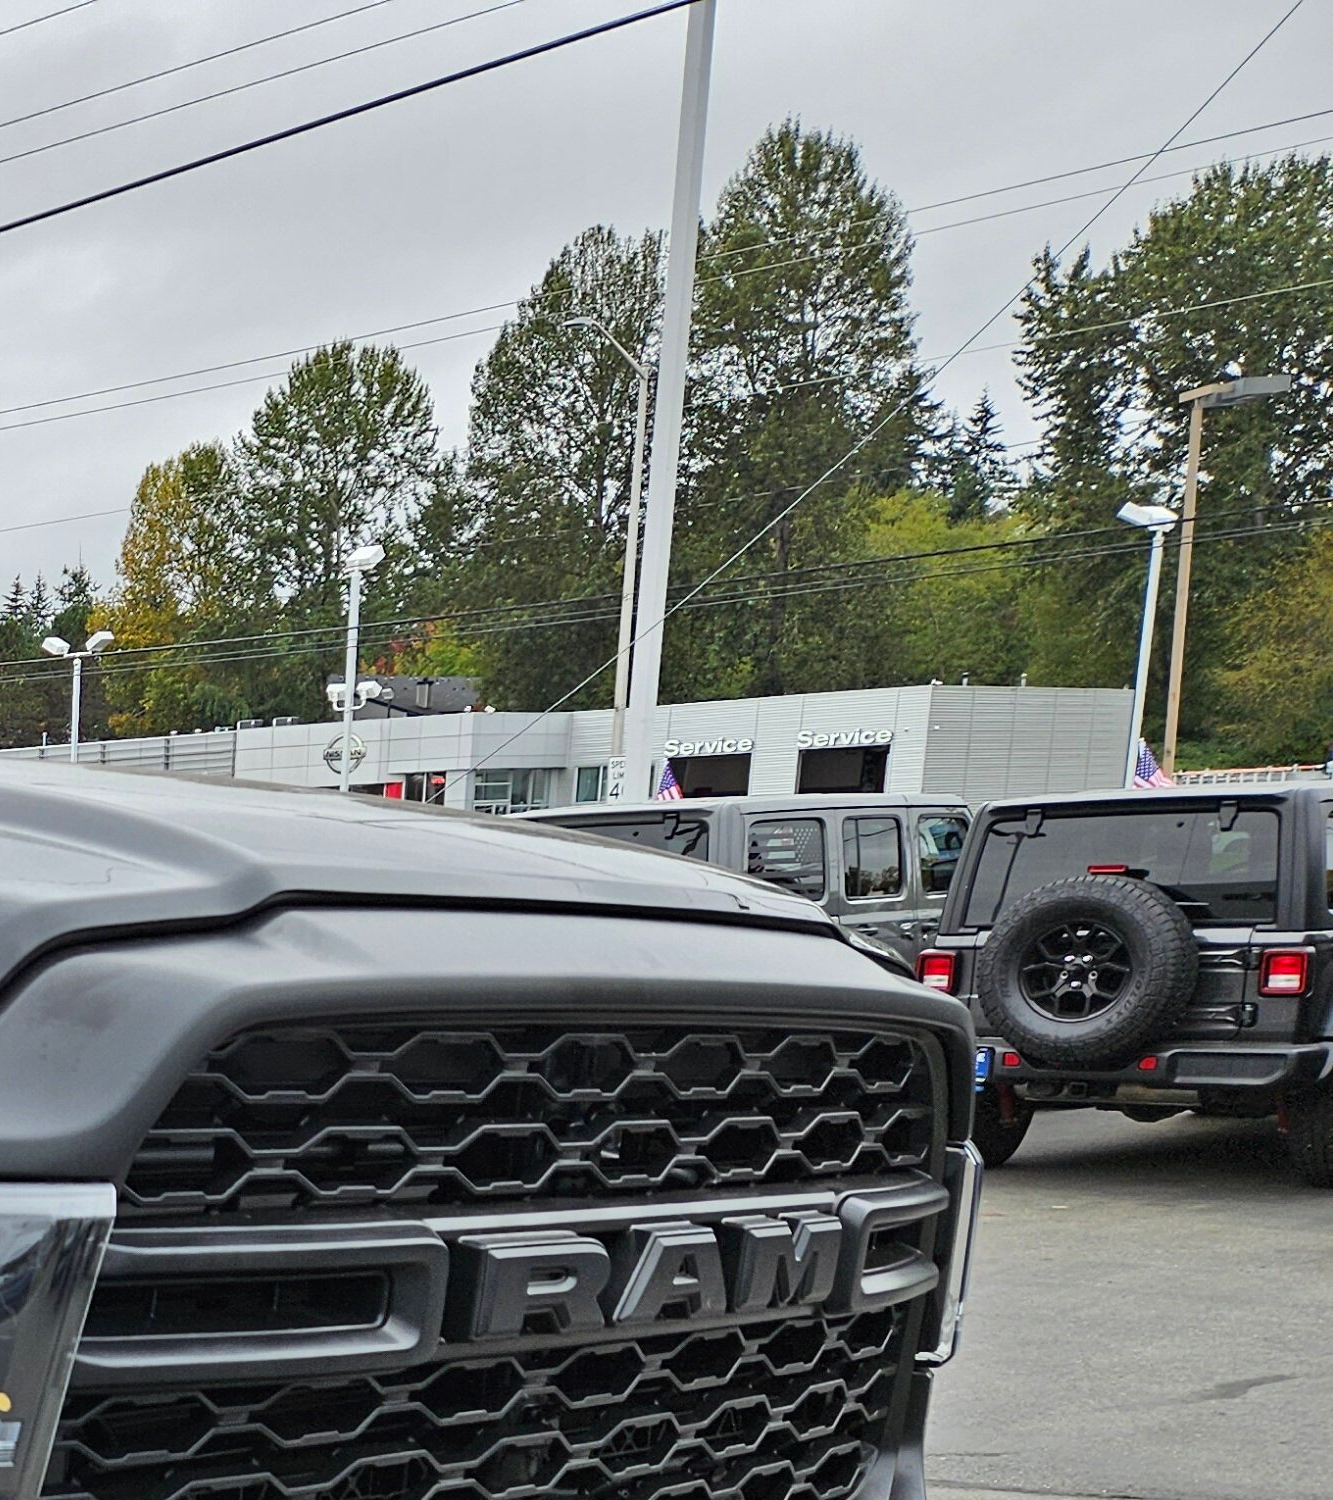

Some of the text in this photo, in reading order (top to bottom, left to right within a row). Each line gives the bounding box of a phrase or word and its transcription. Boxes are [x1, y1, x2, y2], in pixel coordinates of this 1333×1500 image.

[663, 736, 754, 757] Service
[796, 728, 894, 748] Service
[325, 749, 362, 759] NISAN
[461, 1211, 842, 1341] RAM
